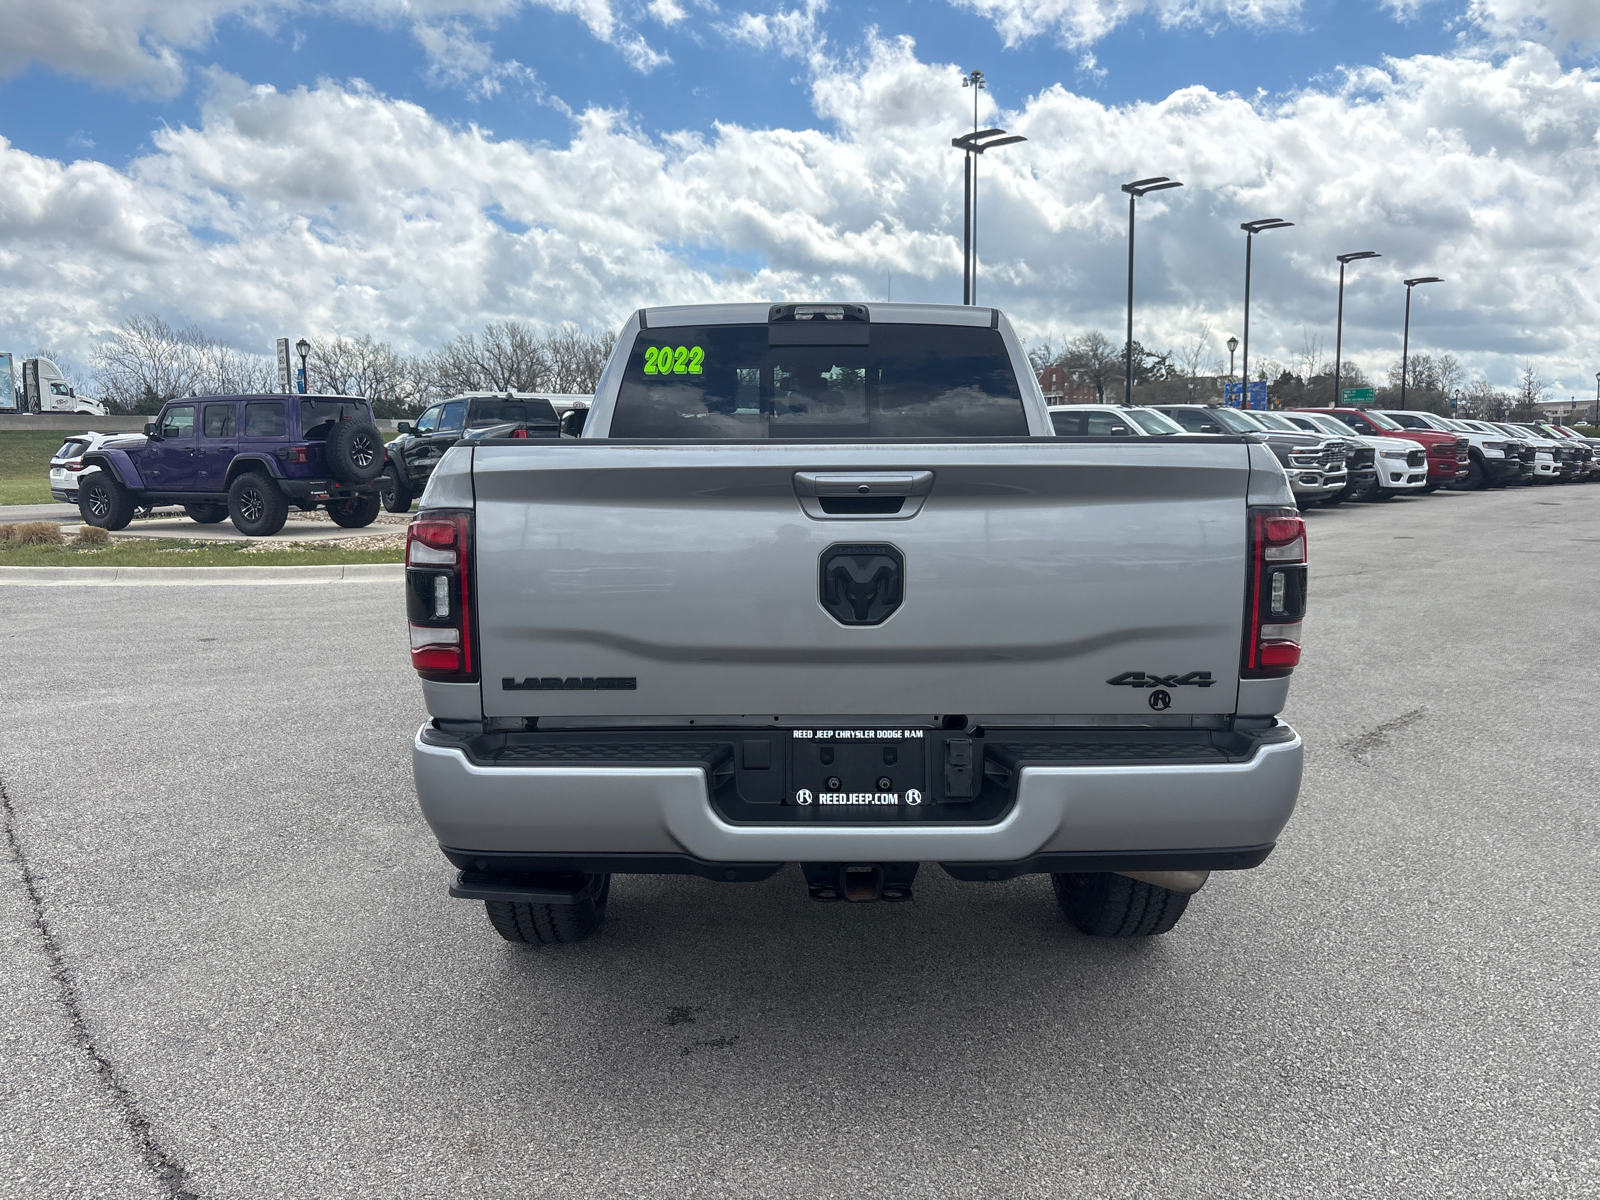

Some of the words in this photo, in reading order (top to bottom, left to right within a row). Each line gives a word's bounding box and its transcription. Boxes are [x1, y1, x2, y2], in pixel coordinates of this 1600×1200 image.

[643, 345, 705, 376] 2022
[501, 676, 637, 691] LARAMIE
[1105, 671, 1218, 688] 4x4
[793, 730, 813, 739] REED
[815, 730, 833, 739] JEEP
[835, 730, 875, 739] CHRYSLER
[877, 730, 903, 739] DODGE
[905, 730, 923, 739] RAM
[819, 793, 899, 805] REEDJEEP.COM
